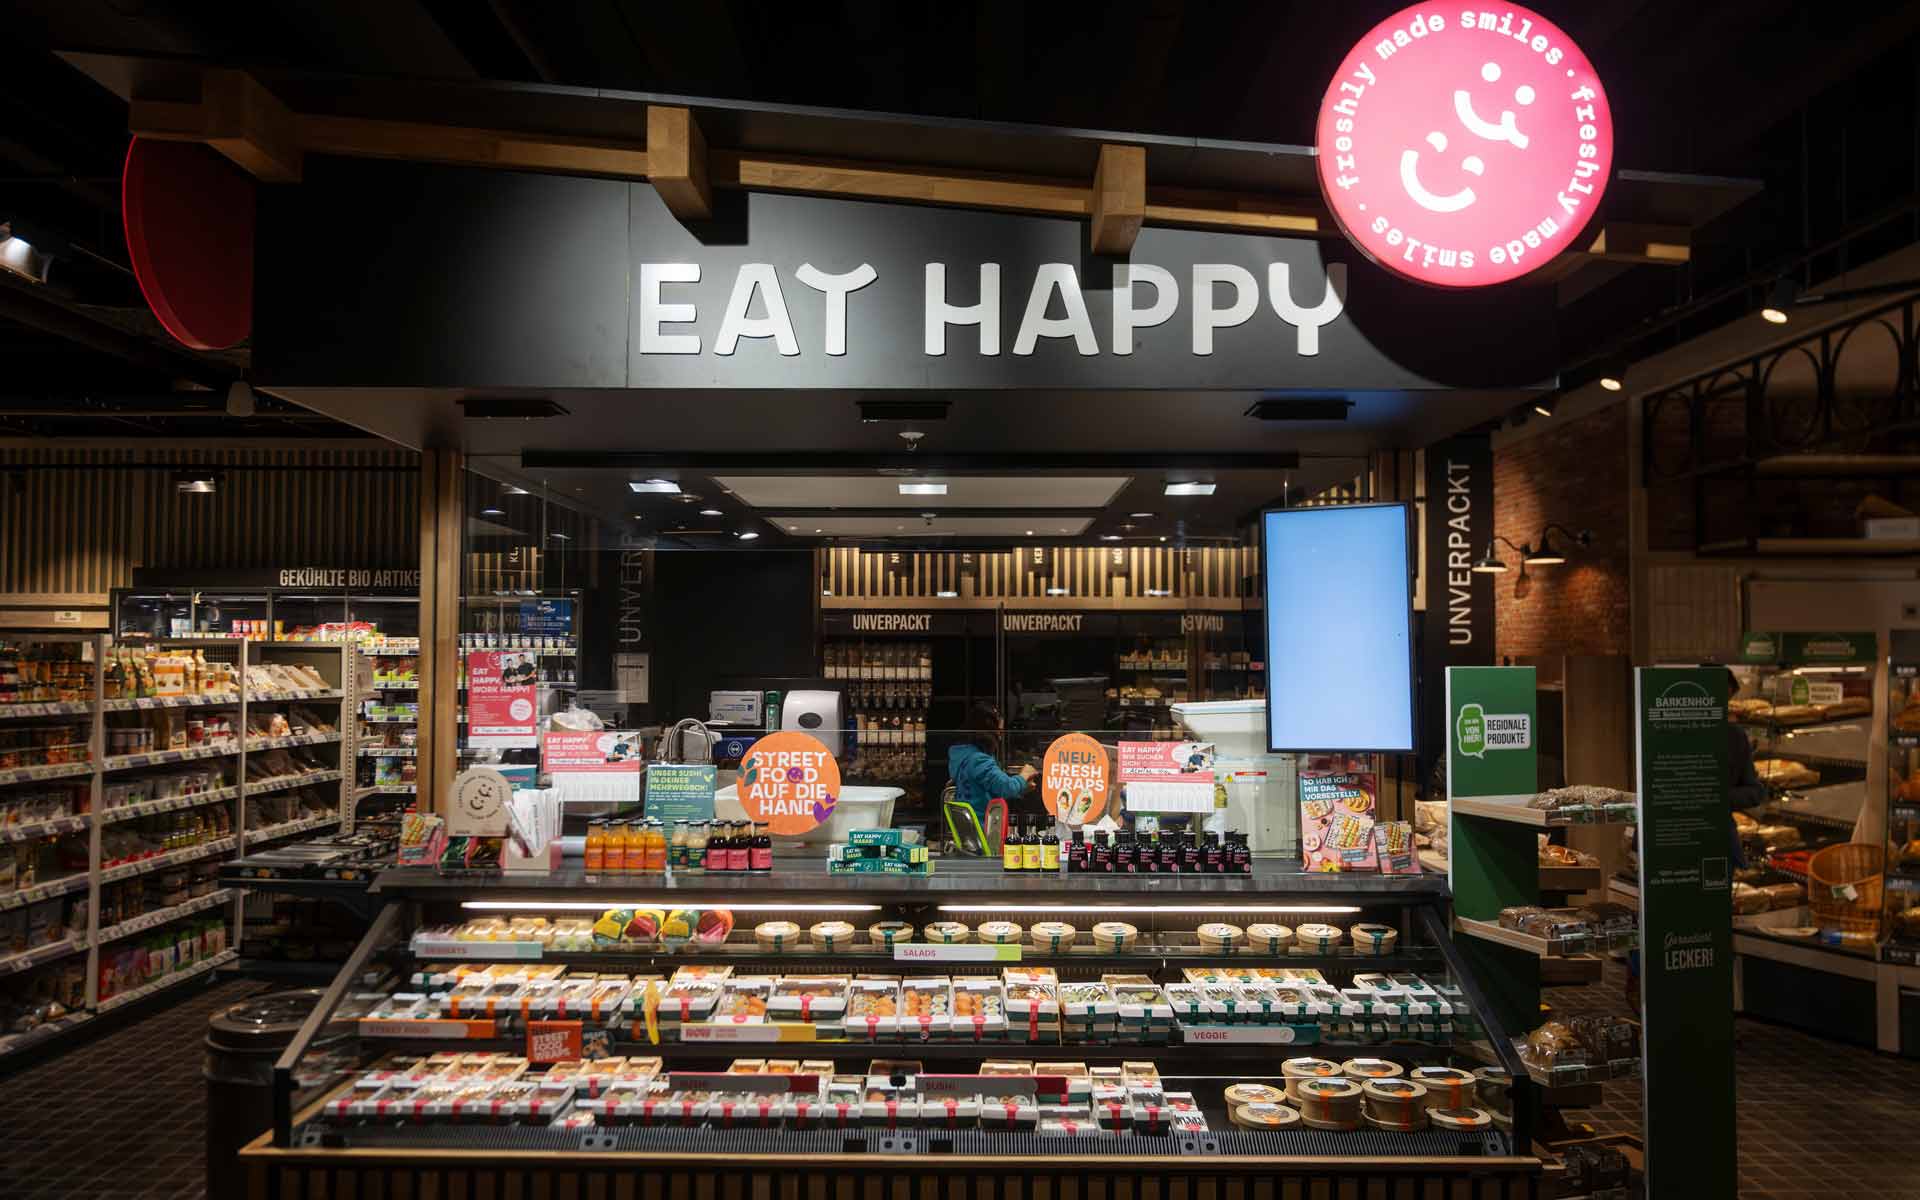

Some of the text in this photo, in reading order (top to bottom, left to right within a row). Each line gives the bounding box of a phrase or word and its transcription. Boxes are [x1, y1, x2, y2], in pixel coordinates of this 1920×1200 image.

[1333, 10, 1563, 189] freshly made smiles
[1372, 85, 1600, 268] freshly made smiles
[639, 262, 1347, 356] EAT HAPPY
[1447, 459, 1472, 645] UNVERPACKT
[280, 567, 345, 587] GEKÜHLTE
[348, 569, 371, 587] BIO
[852, 614, 932, 631] UNVERPACKT
[1003, 614, 1082, 631] UNVERPACKT
[1656, 696, 1716, 707] BARKENHOF
[1487, 719, 1527, 731] REGIONALE
[1487, 732, 1526, 745] PRODUKTE
[752, 752, 827, 767] STREET
[1058, 751, 1096, 764] NEU:
[1051, 764, 1102, 778] FRESH
[750, 784, 827, 799] AUF DIE
[1047, 777, 1104, 791] WRAPS
[760, 799, 816, 816] HAND
[903, 949, 936, 957] SALADS
[1664, 948, 1713, 970] LECKER!
[1193, 1031, 1228, 1040] VEGGIE
